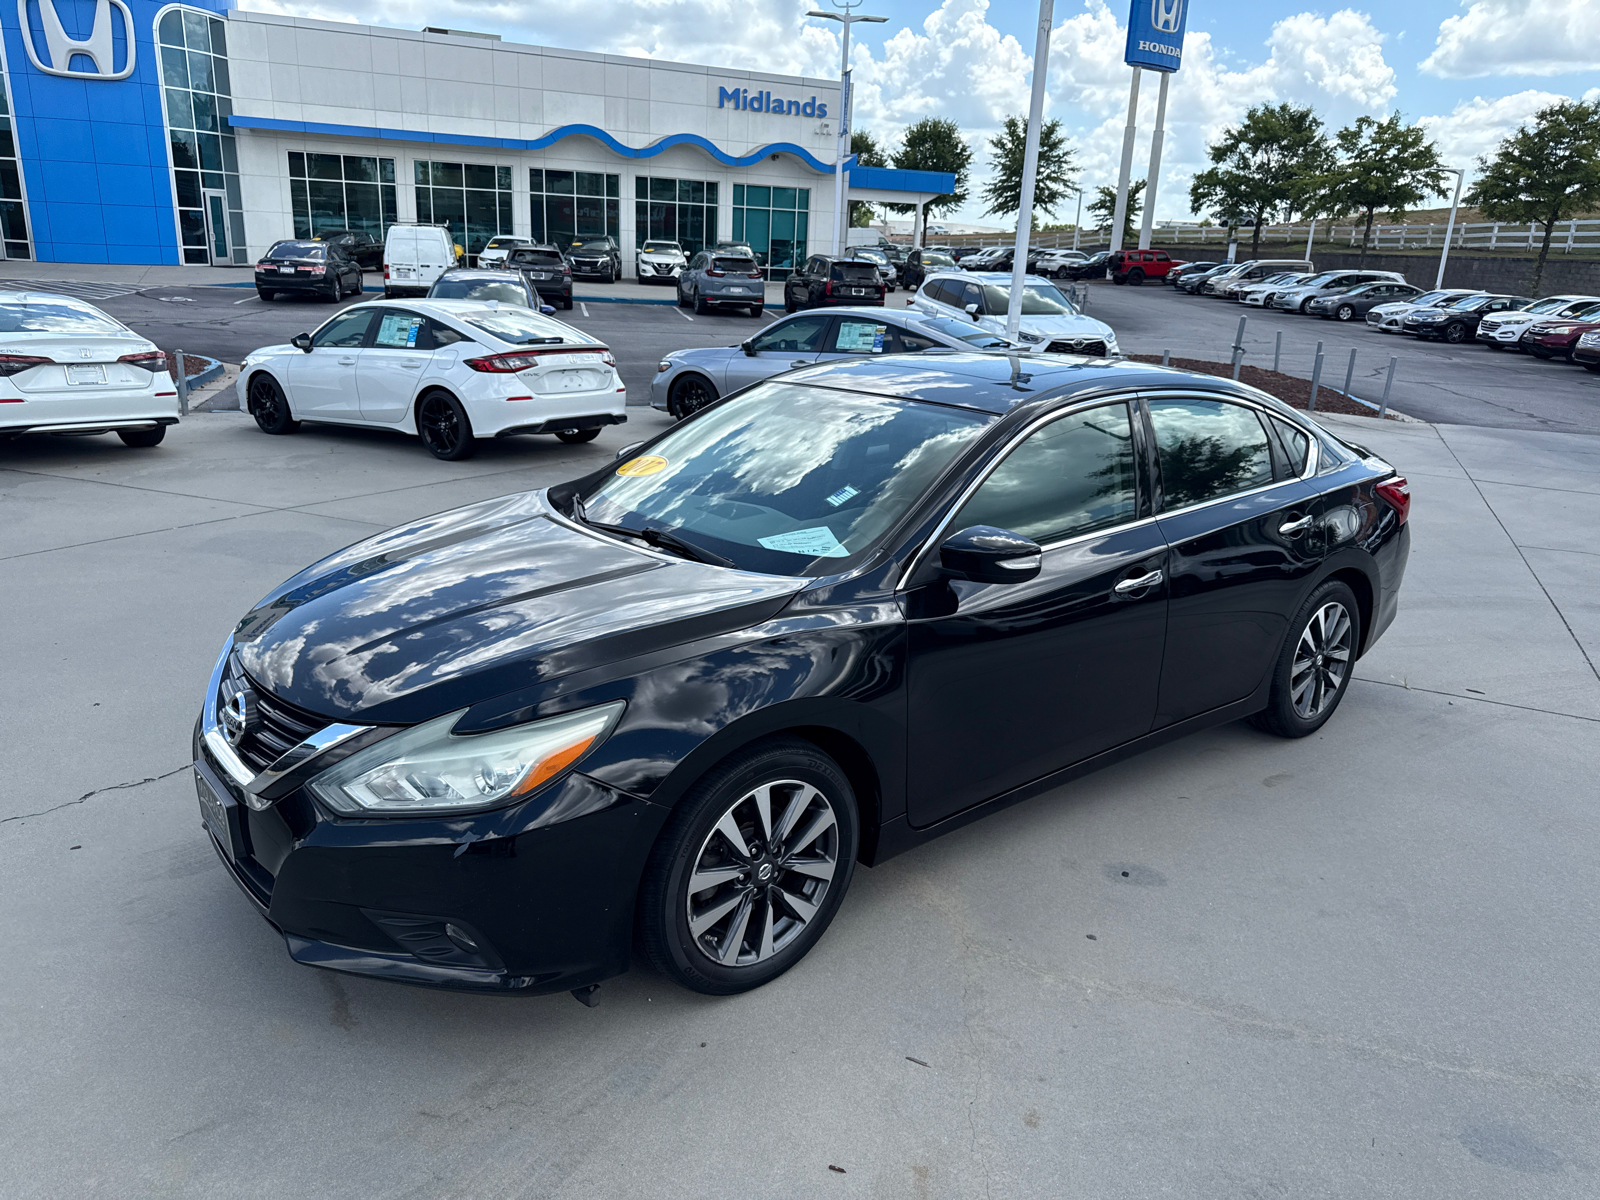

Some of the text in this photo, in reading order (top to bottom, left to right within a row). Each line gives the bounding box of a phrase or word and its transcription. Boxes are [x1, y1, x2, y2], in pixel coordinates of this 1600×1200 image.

[1138, 40, 1181, 58] HONDA
[718, 86, 828, 118] Midlands
[807, 758, 845, 791] DEXTERO
